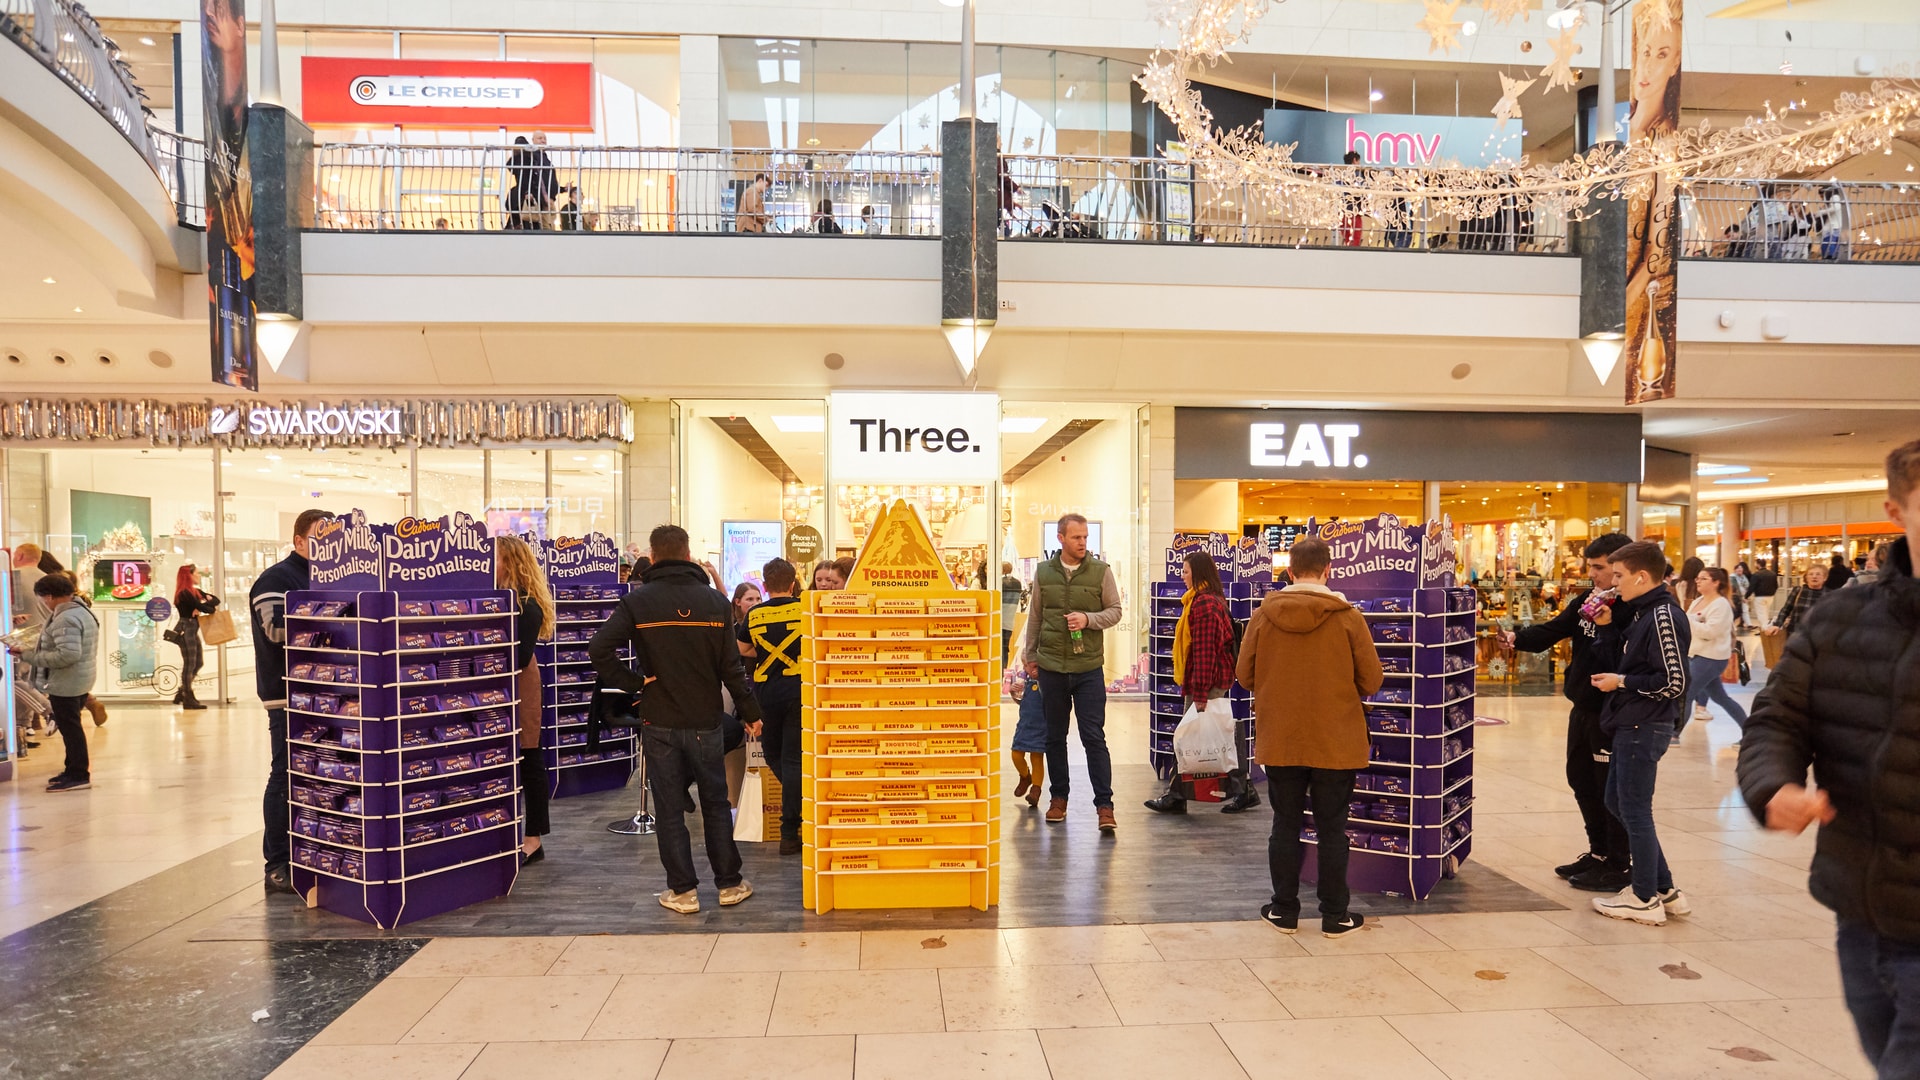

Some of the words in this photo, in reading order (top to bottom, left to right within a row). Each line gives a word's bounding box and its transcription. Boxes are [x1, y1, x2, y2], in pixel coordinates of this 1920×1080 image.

[389, 85, 416, 97] LE
[421, 86, 524, 99] CREUSET
[1345, 118, 1441, 165] hmv
[220, 308, 248, 326] SAUVAGE
[249, 409, 402, 435] SWAROVSKI
[849, 418, 981, 453] Three.
[1249, 423, 1369, 469] EAT.
[397, 517, 441, 538] Cadbury
[1320, 521, 1363, 541] Cadbury
[308, 537, 343, 563] Dairy
[344, 524, 378, 553] Milk
[386, 534, 442, 561] Dairy
[444, 526, 491, 553] Milk
[731, 535, 749, 544] half
[751, 536, 777, 545] price
[1328, 539, 1363, 562] airy
[1365, 528, 1418, 553] Milk
[1424, 537, 1440, 563] Dairy
[548, 547, 585, 565] Dairy
[586, 543, 617, 559] Milk
[1201, 543, 1234, 559] Milk
[1238, 548, 1256, 565] Dairy
[310, 556, 379, 583] Personalised
[388, 555, 491, 581] Personalised
[549, 560, 617, 577] Personalised
[862, 568, 939, 581] TOBLERONE
[1238, 560, 1272, 578] Personalised
[1330, 555, 1417, 579] rsonalised
[1424, 558, 1455, 581] Personalised
[406, 638, 426, 647] WILLIAM
[445, 637, 464, 645] WILLIAM
[484, 634, 502, 642] WILLIAM
